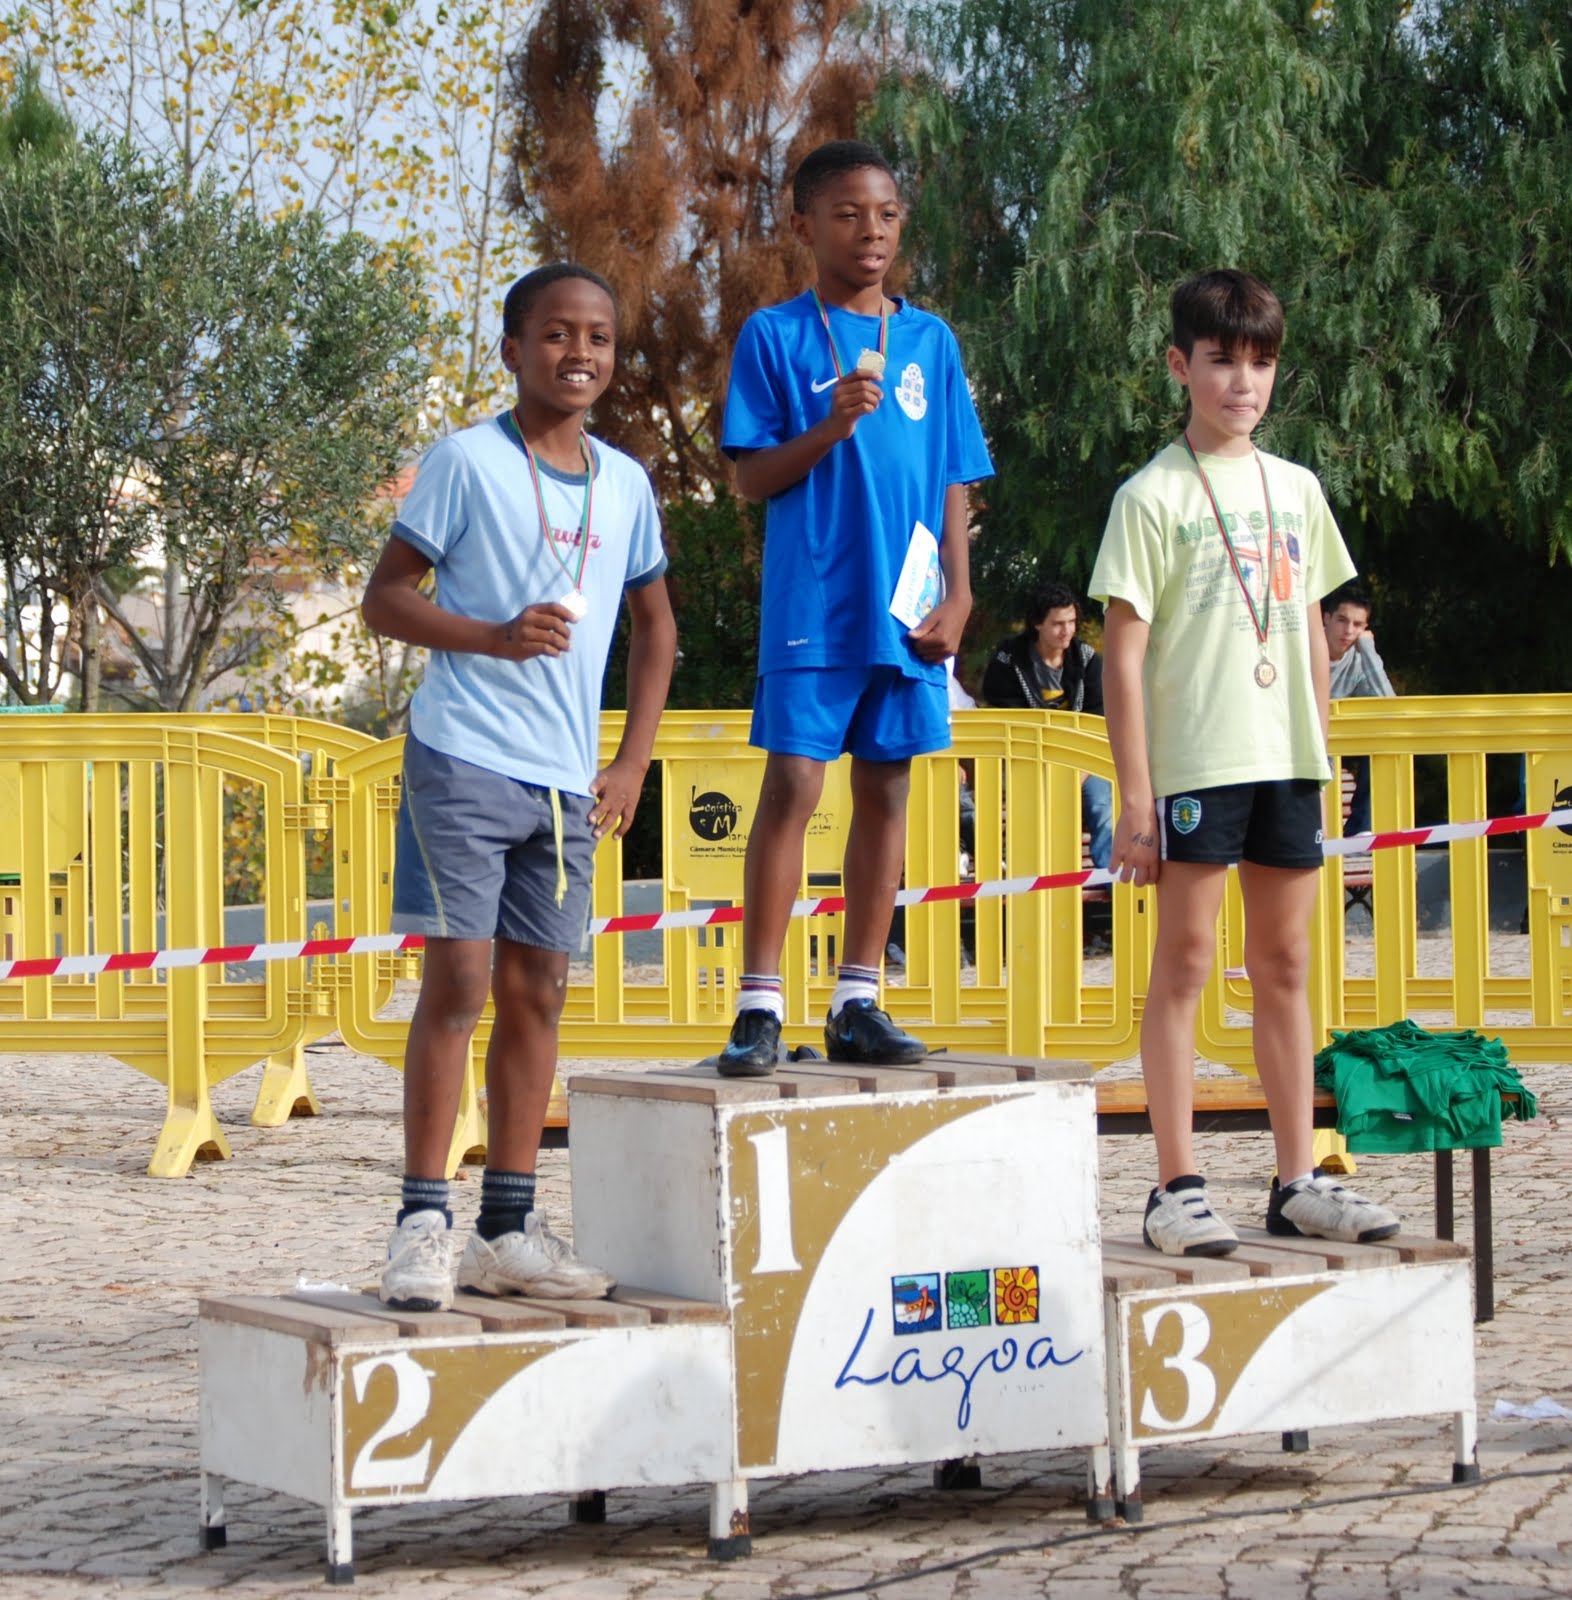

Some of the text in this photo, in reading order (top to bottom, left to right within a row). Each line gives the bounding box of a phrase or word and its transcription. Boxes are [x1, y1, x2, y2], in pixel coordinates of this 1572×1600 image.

[690, 785, 742, 816] Logística
[748, 1125, 801, 1274] 1
[350, 1350, 432, 1489] 2
[835, 1307, 1083, 1431] Lagoa
[1140, 1302, 1217, 1430] 3
